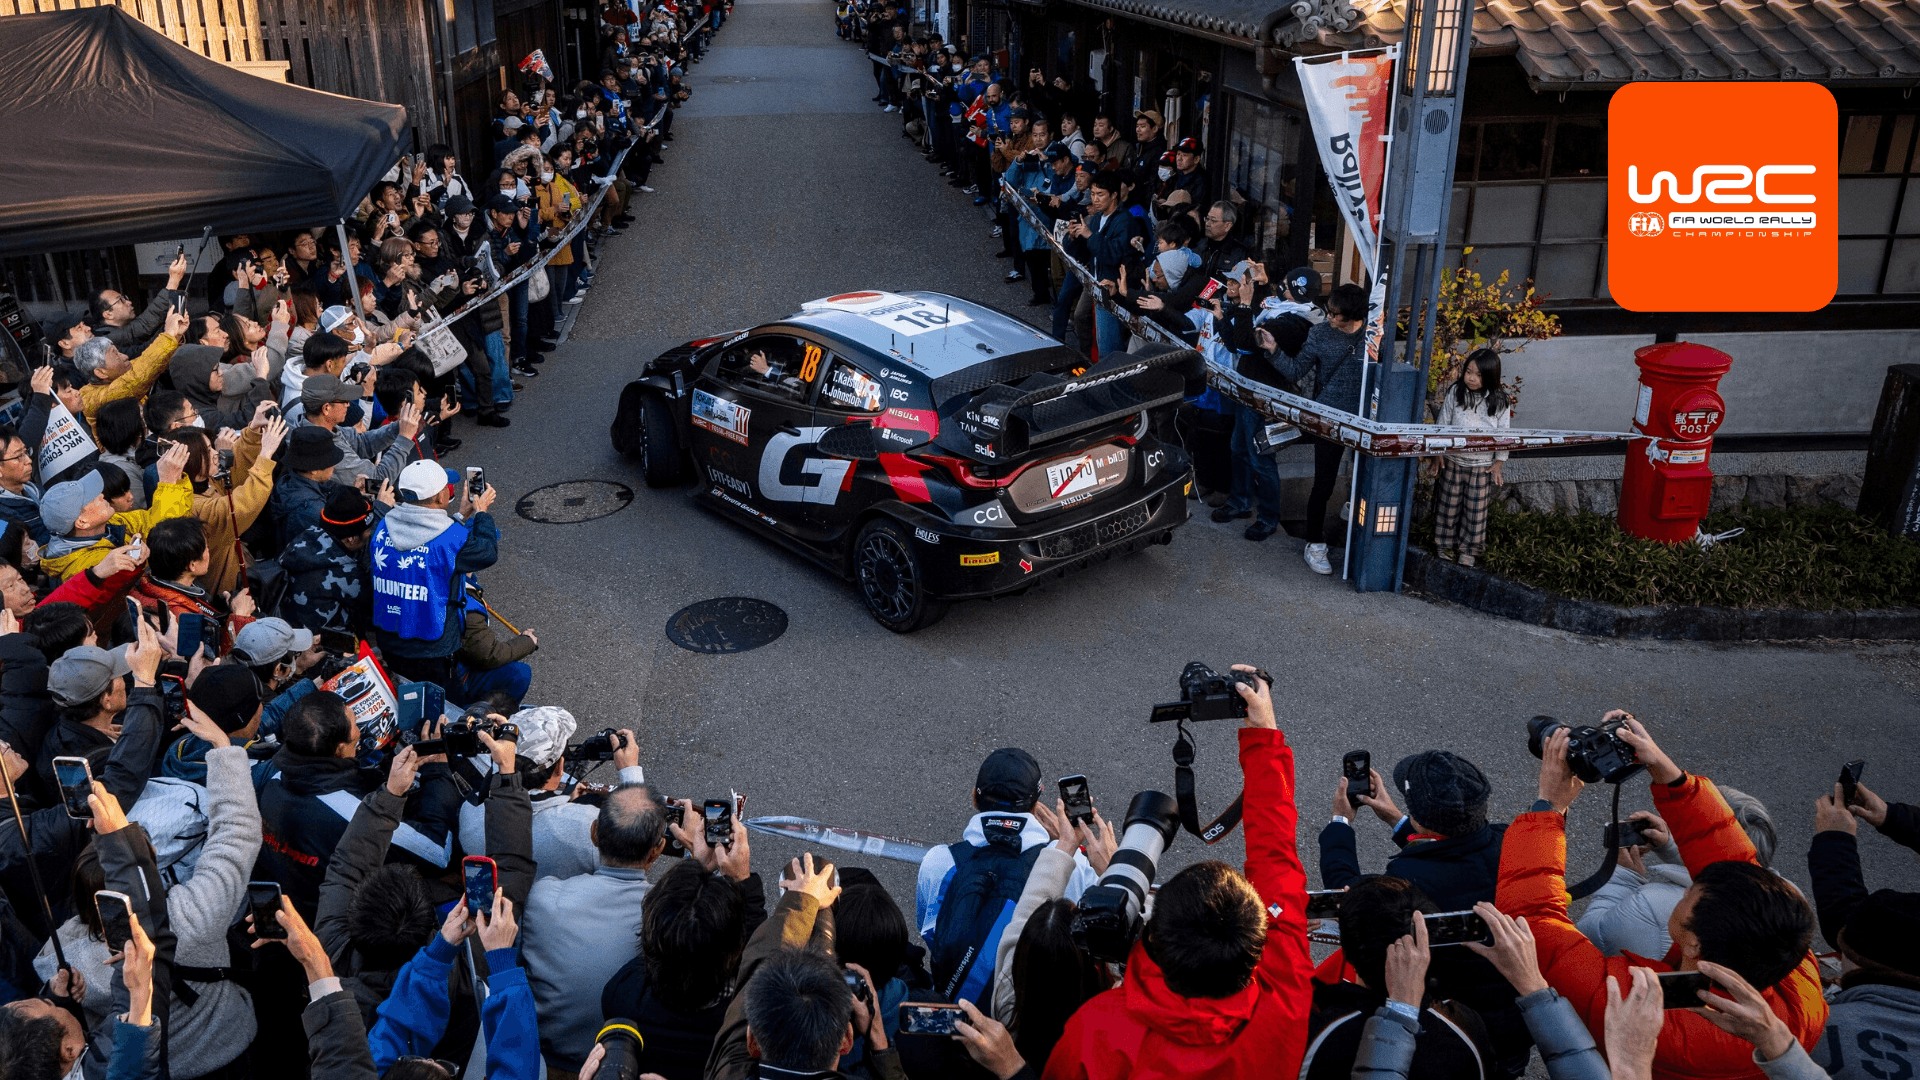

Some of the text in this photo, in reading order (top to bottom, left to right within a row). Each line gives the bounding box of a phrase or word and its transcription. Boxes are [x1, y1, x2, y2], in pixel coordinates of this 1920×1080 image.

[894, 310, 951, 329] 18
[799, 345, 822, 383] 18
[832, 370, 865, 391] T.Katsu
[1061, 364, 1149, 396] Panasonic
[735, 407, 750, 434] HY
[889, 408, 920, 421] NISULA
[1680, 424, 1710, 433] POST
[52, 428, 80, 450] RALLY
[62, 435, 86, 452] WRC
[890, 432, 914, 445] Microsoft
[975, 443, 996, 458] Stilo
[1096, 455, 1118, 468] Mobil
[1060, 492, 1093, 506] NISULA
[915, 527, 940, 543] ENDLESS
[196, 602, 215, 616] Canon
[368, 699, 386, 716] 2024
[1203, 823, 1225, 840] EOS
[951, 946, 975, 982] Motorsport
